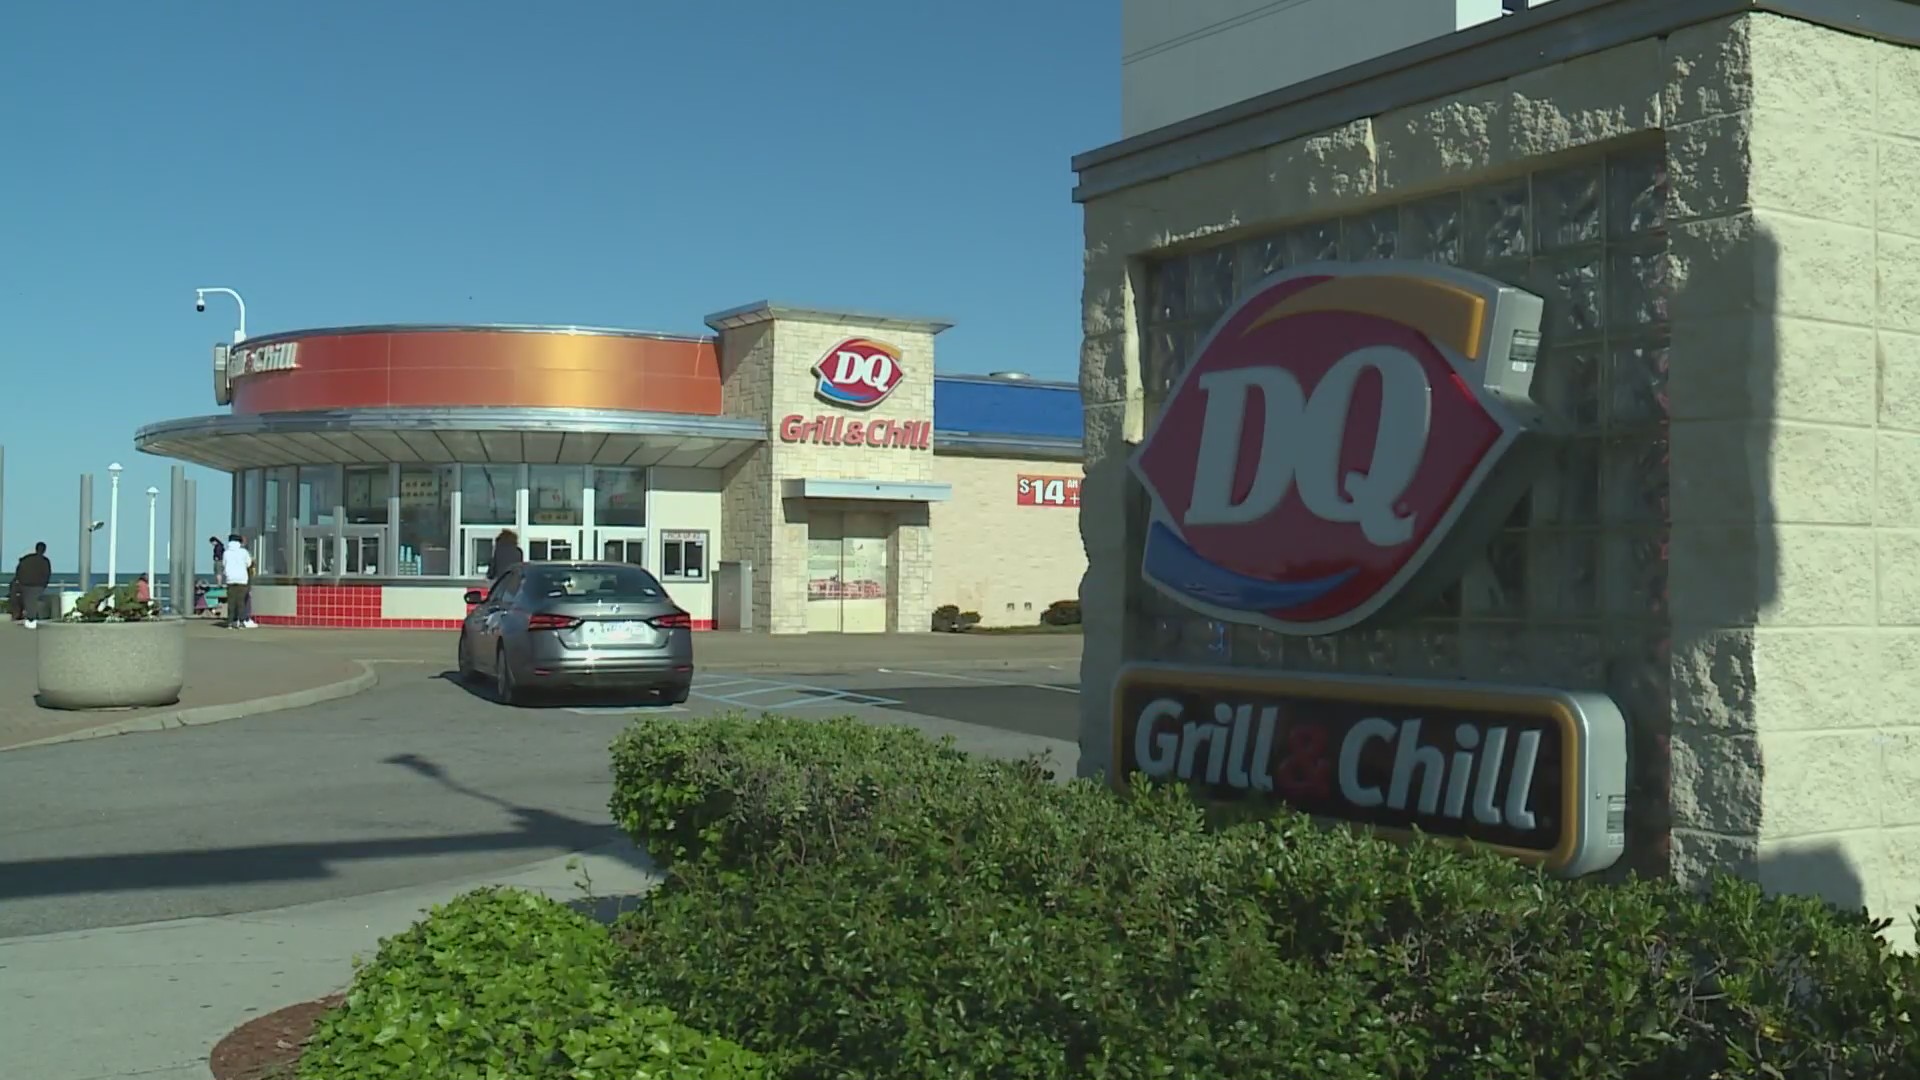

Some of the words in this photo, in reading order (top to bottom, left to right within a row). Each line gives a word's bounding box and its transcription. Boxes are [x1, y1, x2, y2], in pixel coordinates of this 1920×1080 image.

[832, 351, 893, 393] DQ
[1184, 344, 1432, 547] DQ
[1019, 478, 1066, 505] $14
[1134, 698, 1279, 792] Grill
[1278, 723, 1331, 797] &
[1337, 717, 1542, 830] Chill
